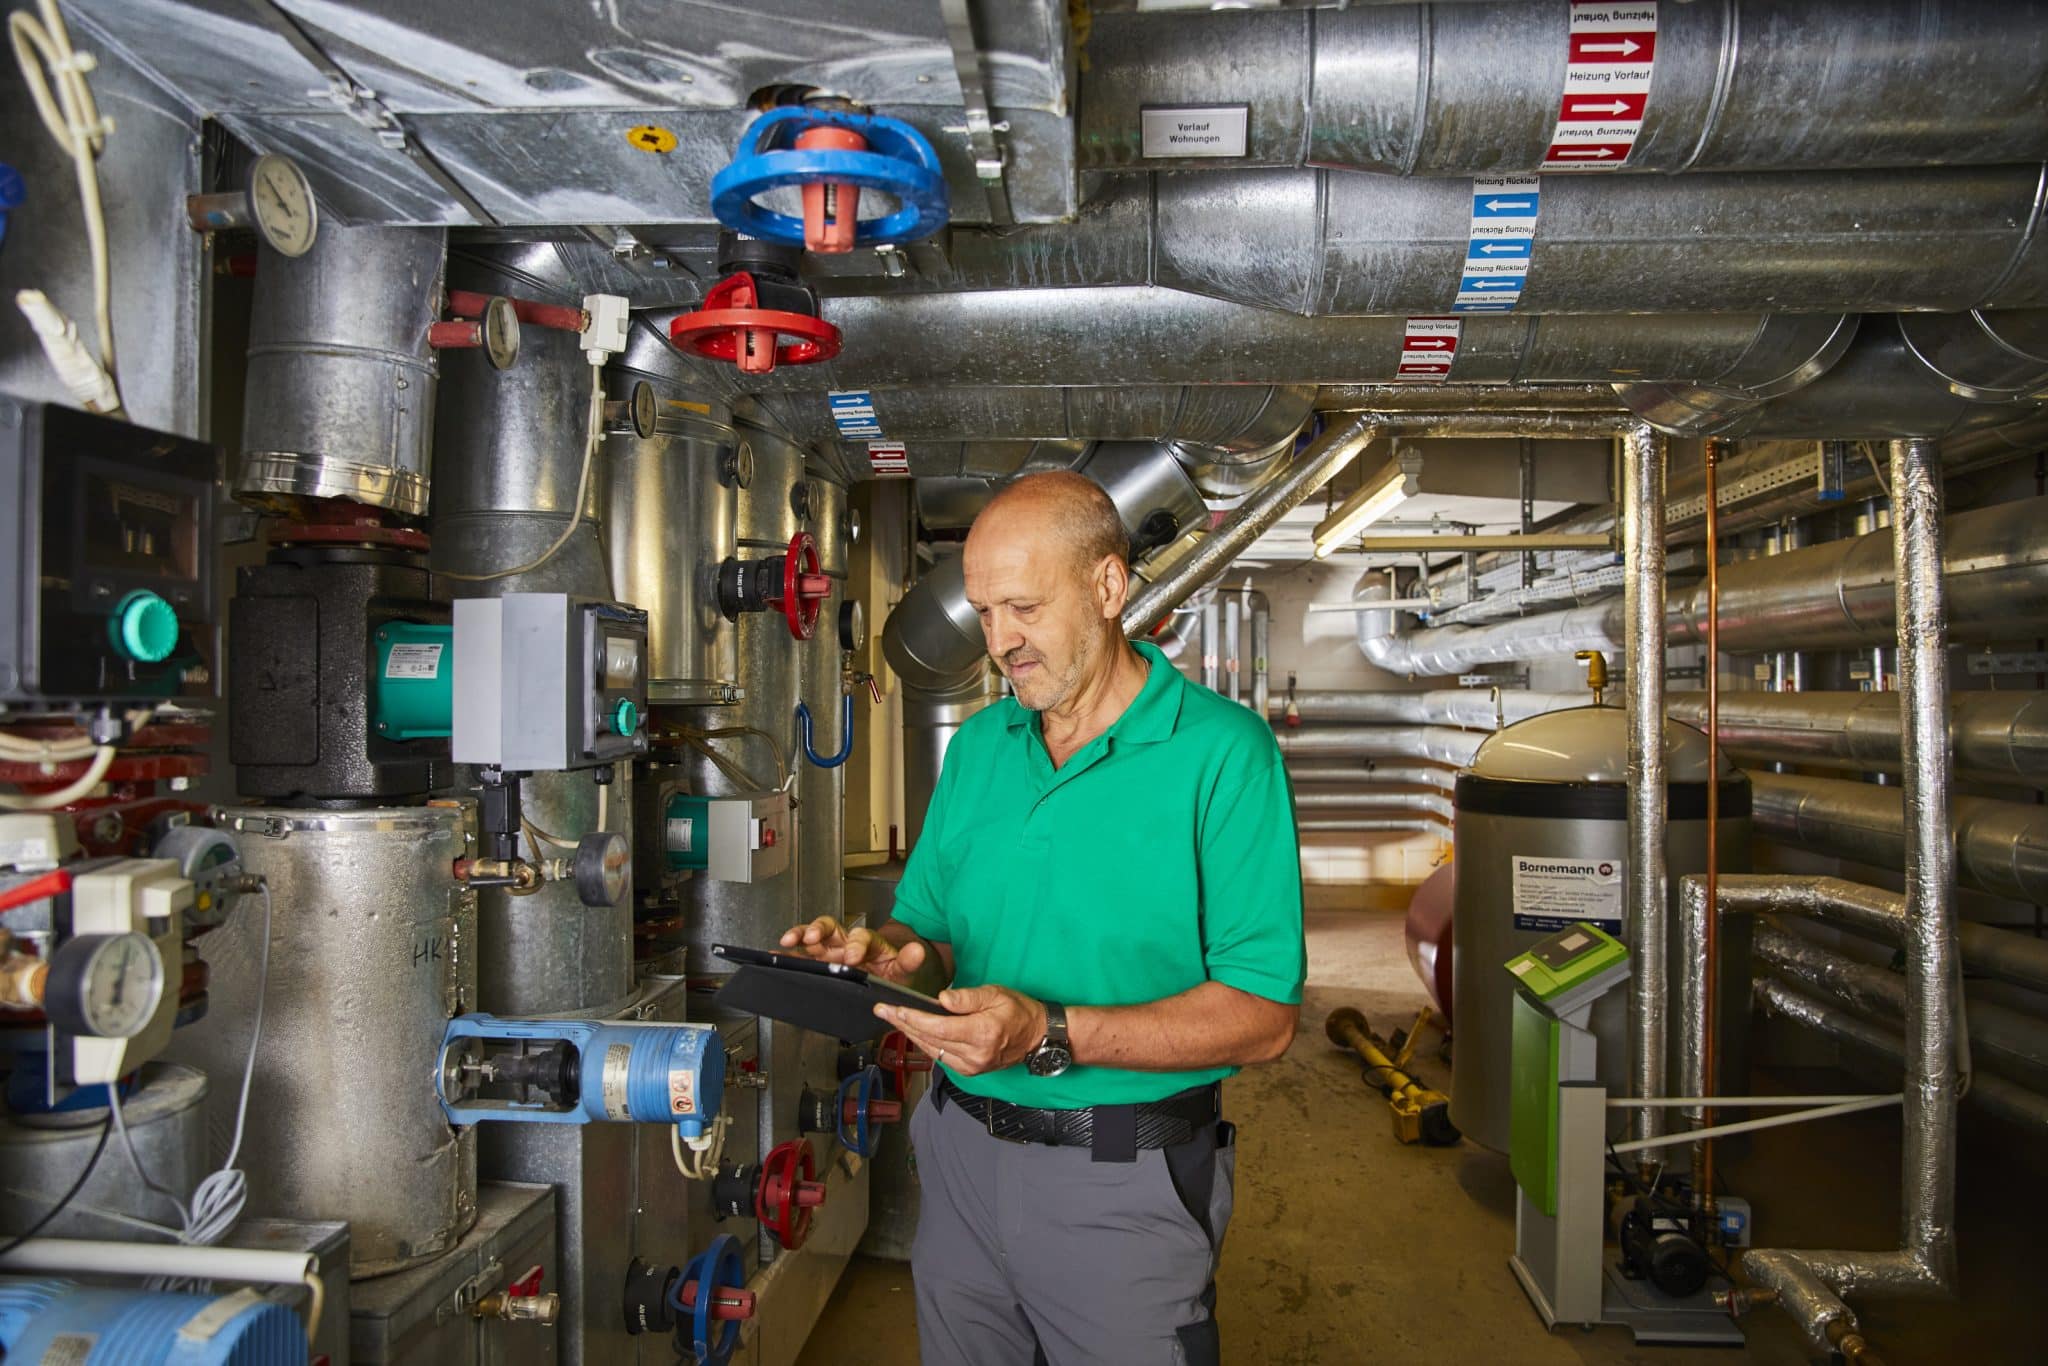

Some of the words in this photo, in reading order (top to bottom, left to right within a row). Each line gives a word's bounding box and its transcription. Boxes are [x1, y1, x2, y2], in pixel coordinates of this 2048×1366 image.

[1574, 12, 1610, 23] Vorlauf
[1613, 10, 1655, 22] Heizung
[1570, 71, 1611, 83] Heizung
[1614, 70, 1650, 81] Vorlauf
[1177, 123, 1210, 132] Vorlauf
[1559, 128, 1593, 137] Vorlauf
[1596, 127, 1637, 136] Heizung
[1169, 135, 1220, 144] Wohnungen
[1474, 177, 1504, 187] Heizung
[1506, 176, 1539, 185] Rücklauf
[1465, 265, 1494, 273] Heizung
[1495, 264, 1528, 272] Rücklauf
[1519, 861, 1595, 875] Bornemann
